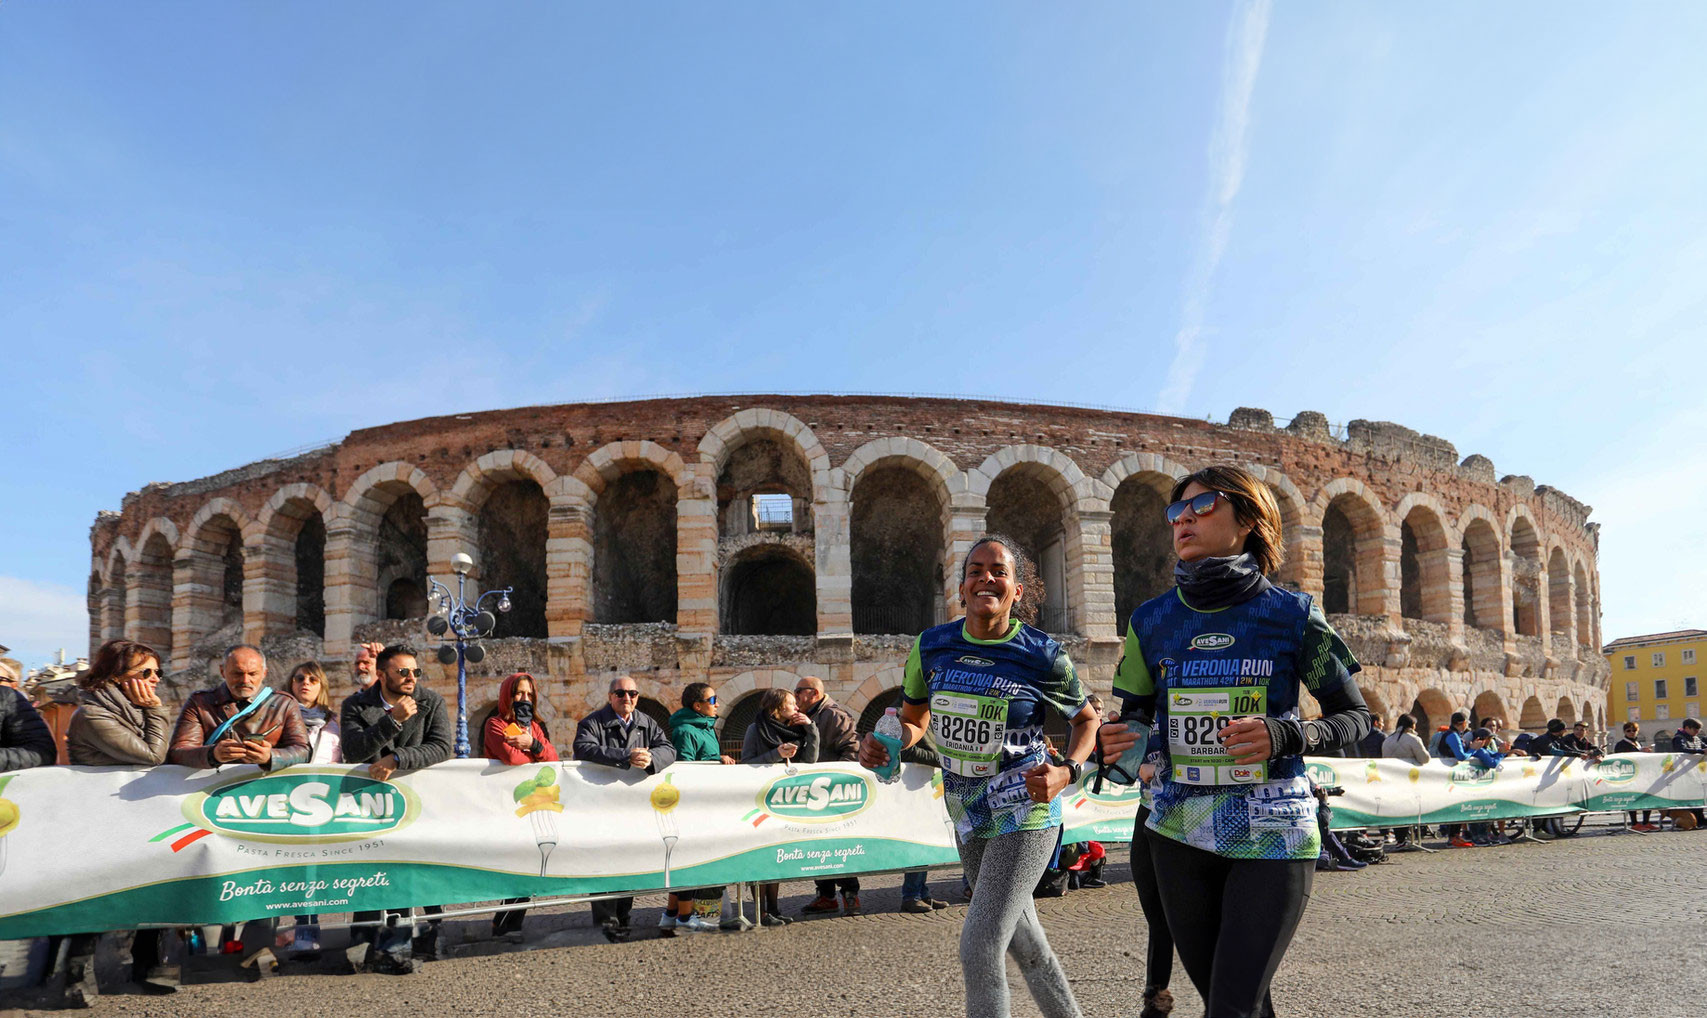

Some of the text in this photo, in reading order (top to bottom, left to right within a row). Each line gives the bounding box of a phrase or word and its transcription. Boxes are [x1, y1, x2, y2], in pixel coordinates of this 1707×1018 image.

[1196, 636, 1229, 646] AVESANI
[1182, 677, 1219, 686] MARATHON
[980, 704, 1004, 721] 10K
[1234, 696, 1262, 713] 10K
[941, 714, 991, 745] 8266
[1184, 715, 1247, 745] 828
[945, 740, 974, 752] ERIDANIA
[1599, 760, 1634, 778] AVESANI
[770, 777, 862, 810] AVESANI
[216, 782, 395, 827] AVESANI
[359, 840, 385, 852] 1951
[776, 848, 805, 863] Bontà
[807, 849, 832, 863] senza
[801, 863, 844, 871] www.avesani.com
[219, 871, 390, 901] Bontà senza segreti.
[265, 899, 349, 910] www.avesani.com
